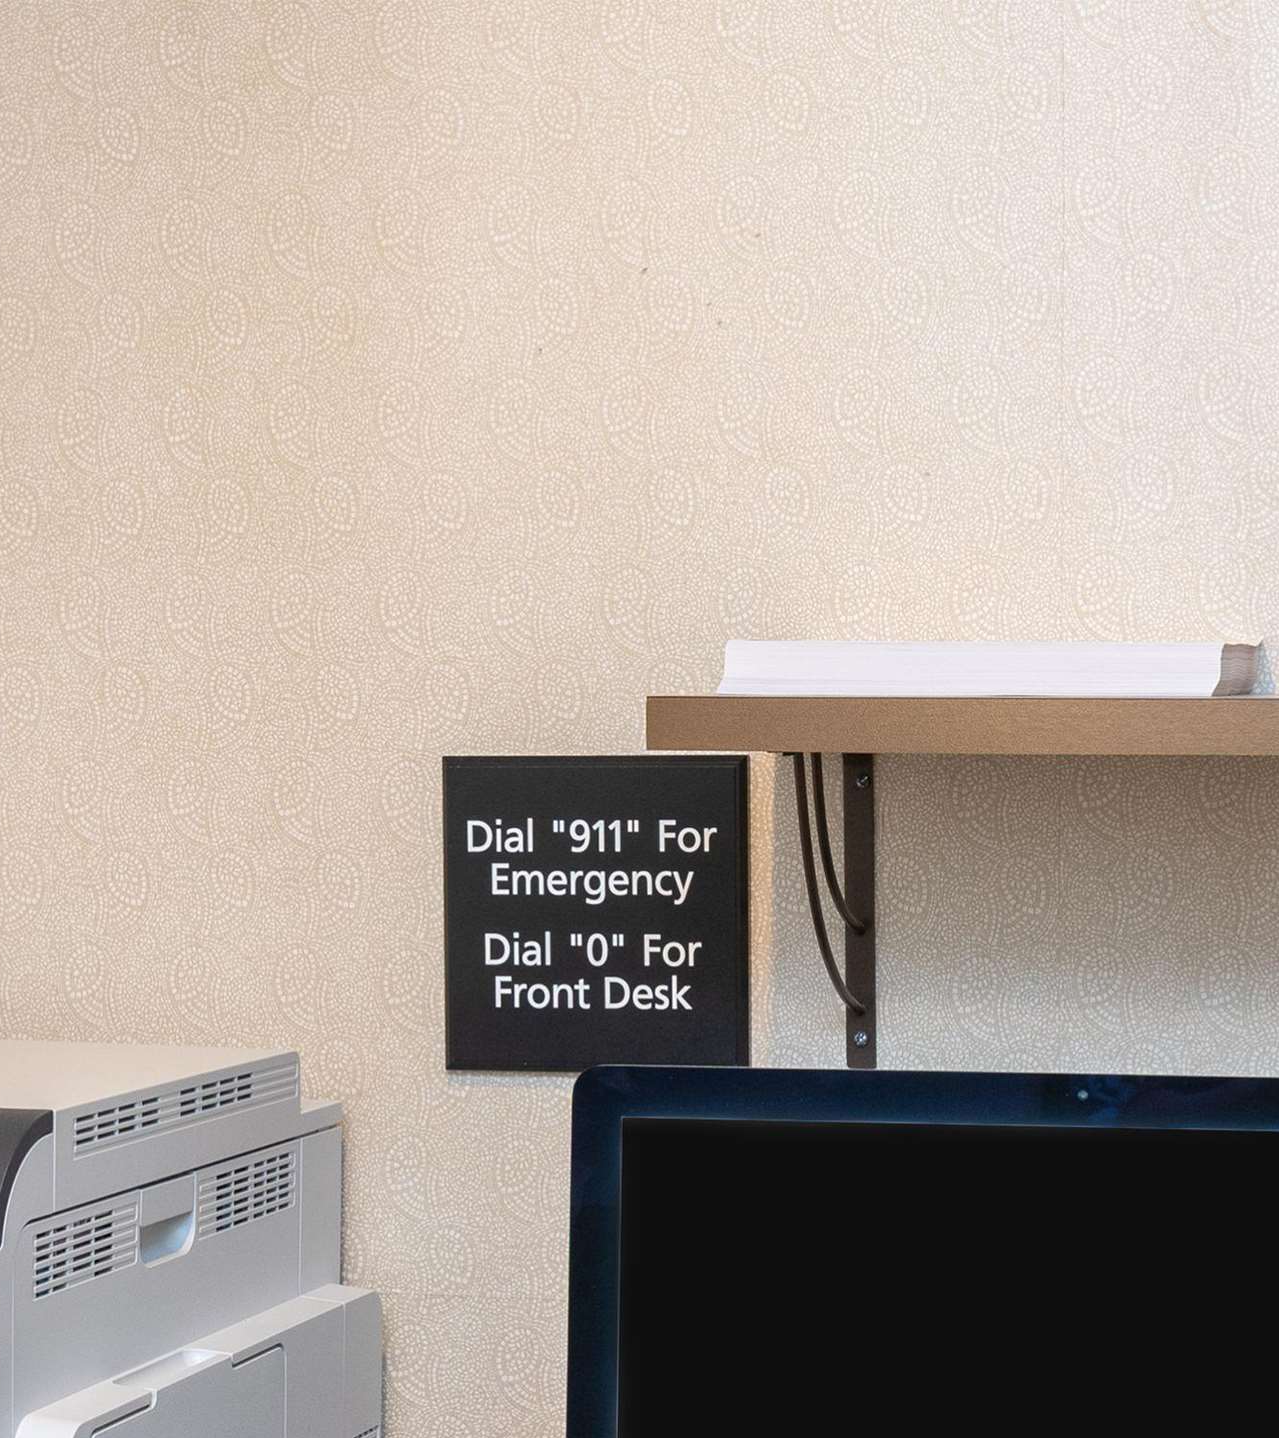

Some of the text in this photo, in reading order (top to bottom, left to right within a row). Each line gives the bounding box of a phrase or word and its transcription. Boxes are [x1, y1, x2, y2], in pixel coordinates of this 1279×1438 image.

[466, 817, 718, 853] Dial "911" For
[491, 862, 695, 905] Emergency
[484, 931, 702, 967] Dial "0" For
[494, 974, 693, 1010] Front Desk
